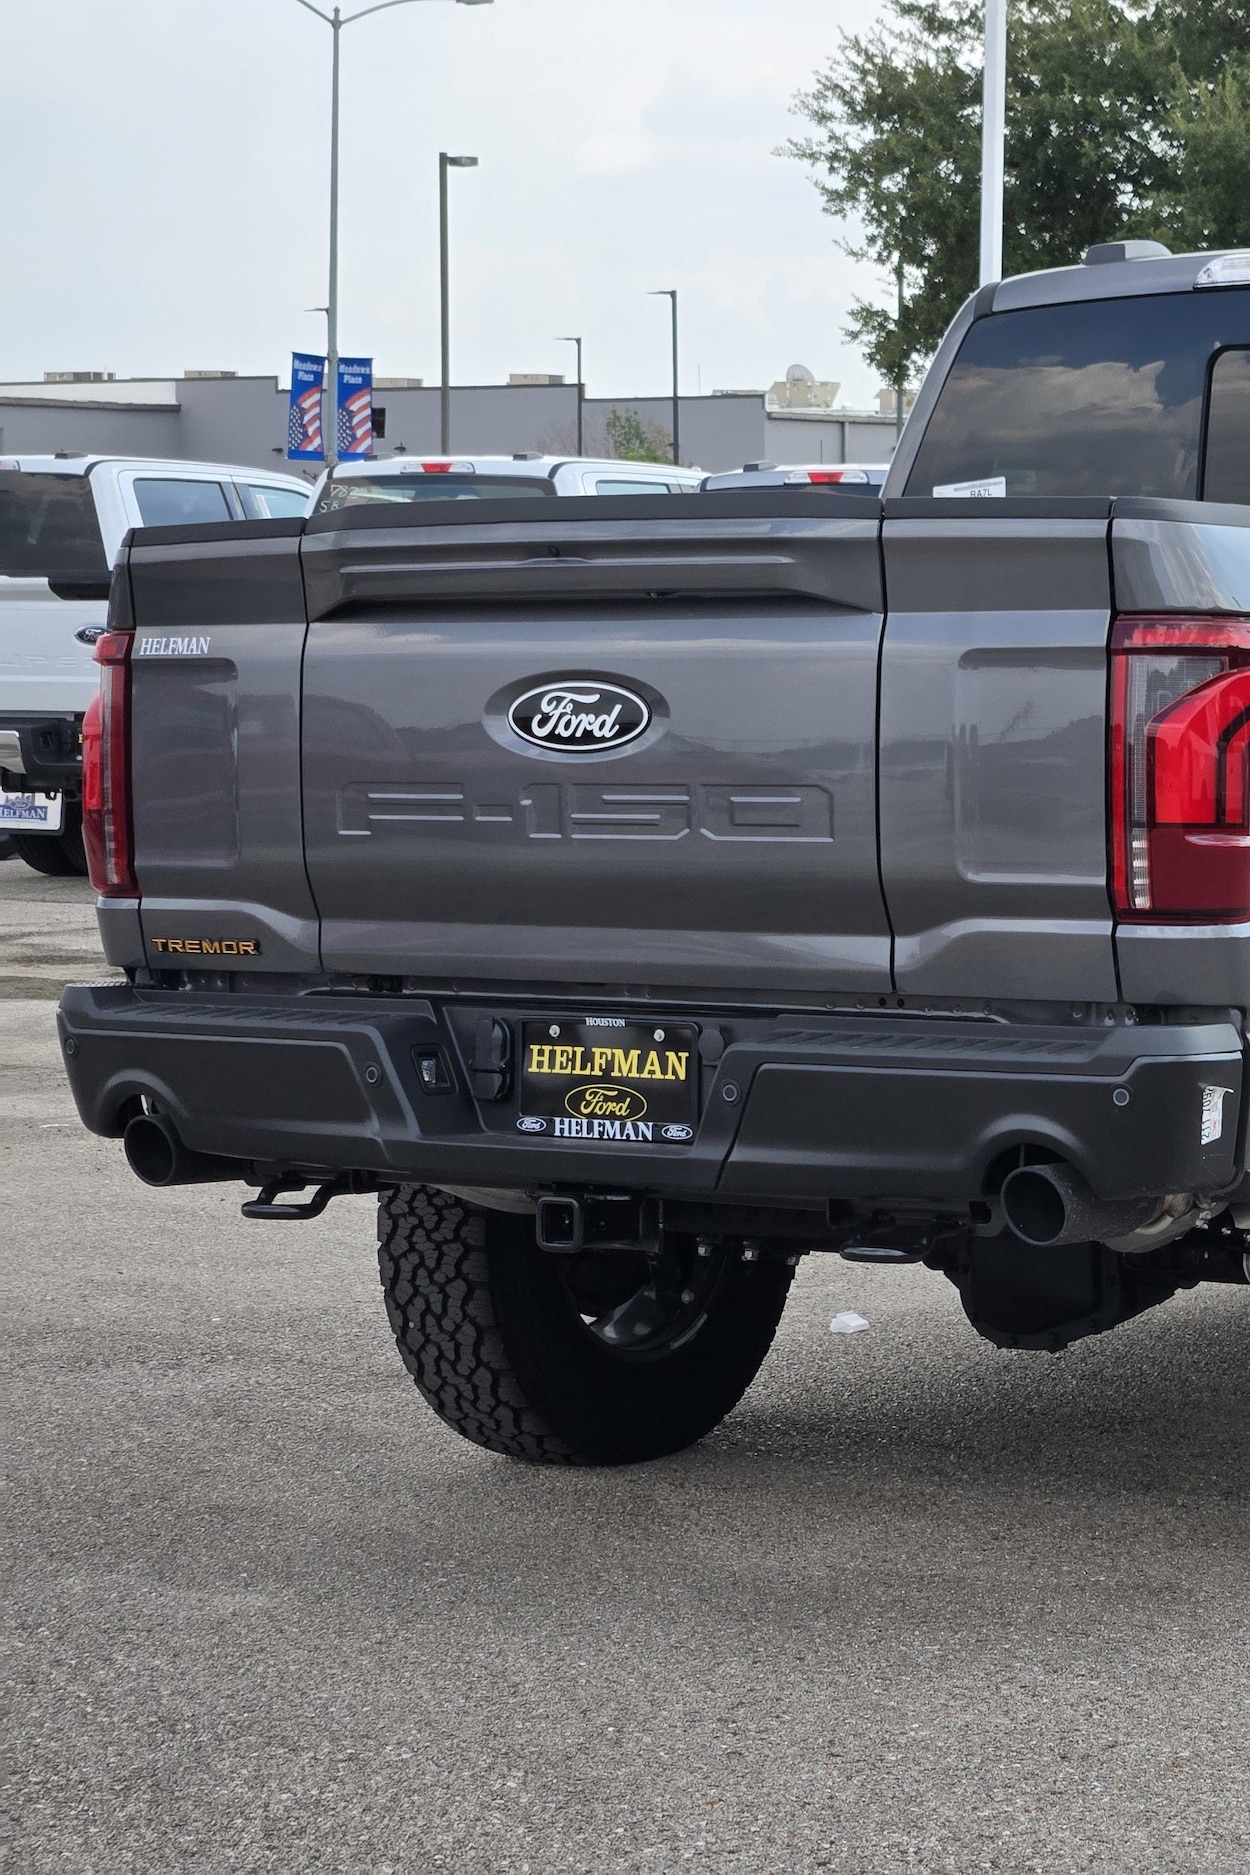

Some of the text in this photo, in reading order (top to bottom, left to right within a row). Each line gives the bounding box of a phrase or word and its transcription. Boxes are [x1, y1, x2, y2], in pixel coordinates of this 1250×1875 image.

[294, 359, 322, 372] Meadows
[339, 363, 370, 374] Meadows
[298, 371, 314, 381] Place
[343, 374, 363, 384] Place
[138, 637, 211, 655] HELFMAN
[531, 691, 622, 739] Ford
[336, 781, 834, 843] F-150
[151, 938, 257, 955] TREMOR
[585, 1017, 626, 1028] HOUSTON
[528, 1045, 690, 1081] HELFMAN
[580, 1088, 631, 1117] Ford
[521, 1119, 542, 1131] Ford
[553, 1117, 654, 1142] HELFMAN
[666, 1127, 687, 1138] Ford
